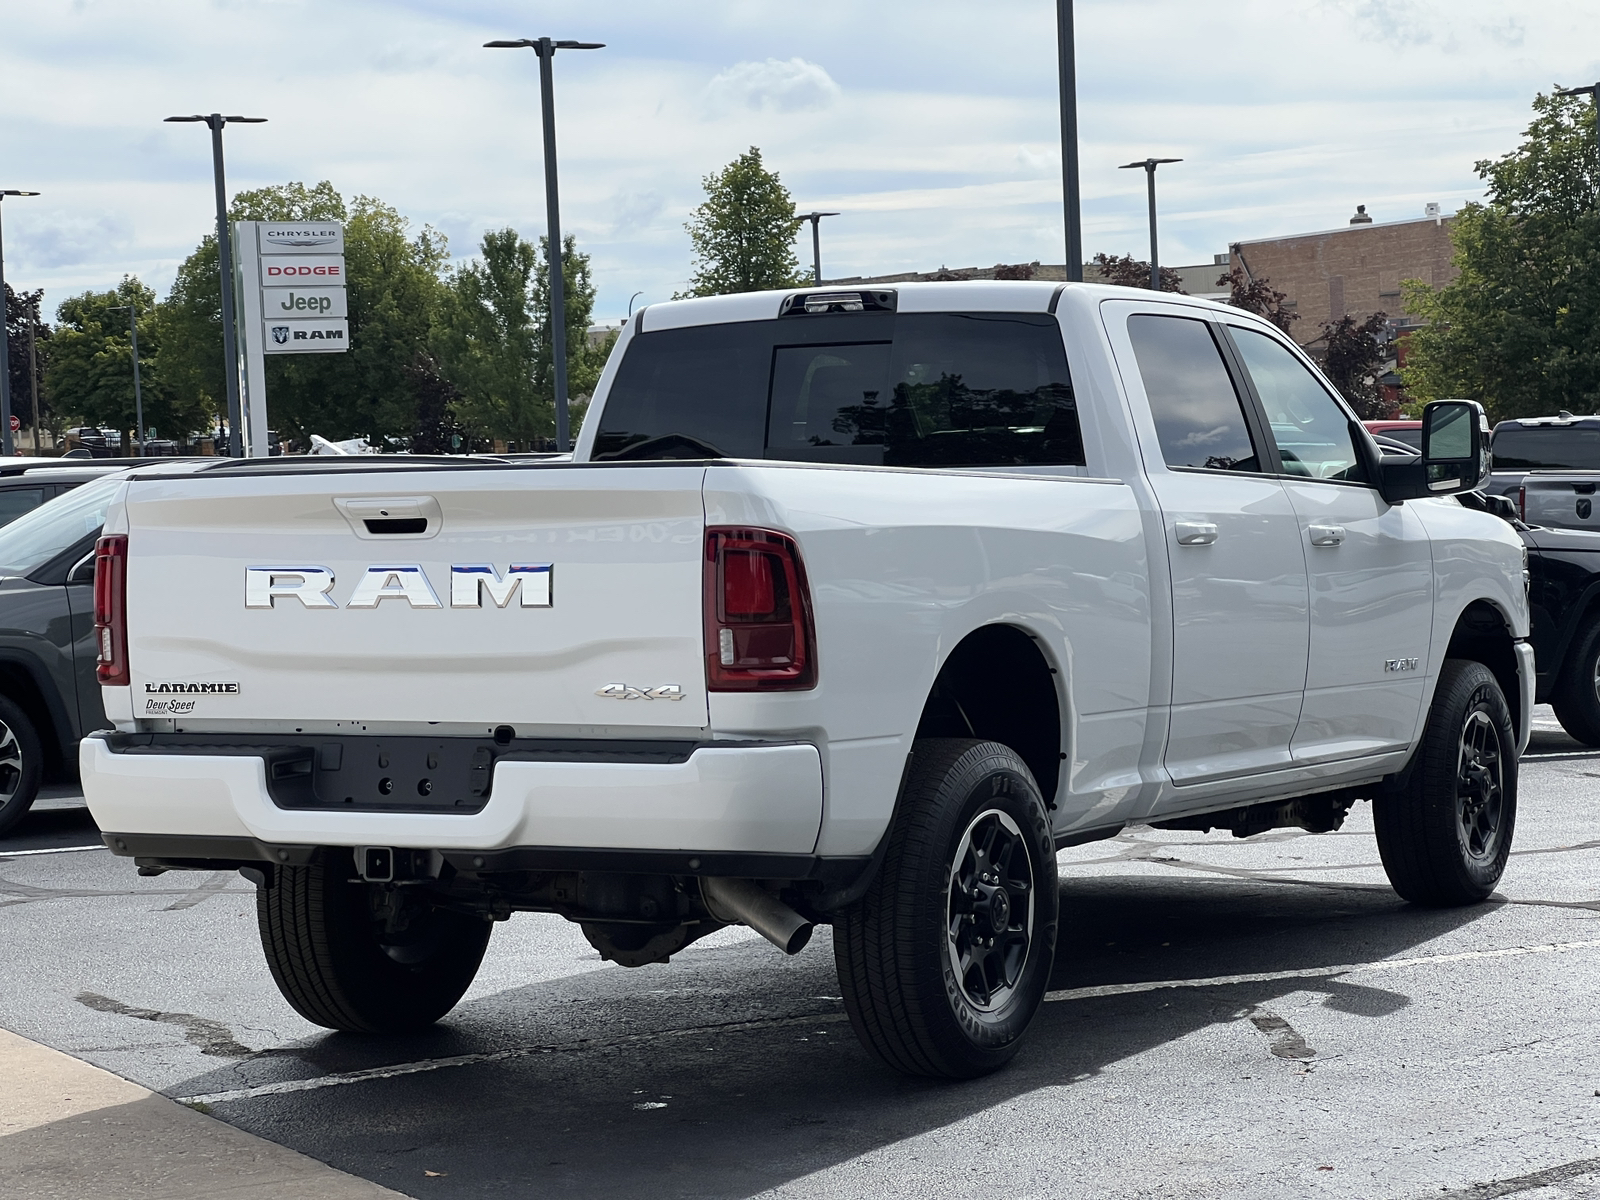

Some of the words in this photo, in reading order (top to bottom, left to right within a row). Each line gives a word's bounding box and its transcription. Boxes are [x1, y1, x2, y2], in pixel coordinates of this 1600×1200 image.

[267, 266, 340, 276] DODGE
[281, 292, 331, 314] Jeep
[293, 329, 344, 340] RAM
[245, 562, 554, 609] RAM
[1384, 657, 1419, 673] RAM
[144, 683, 238, 693] LARAMIE
[595, 682, 687, 702] 4x4
